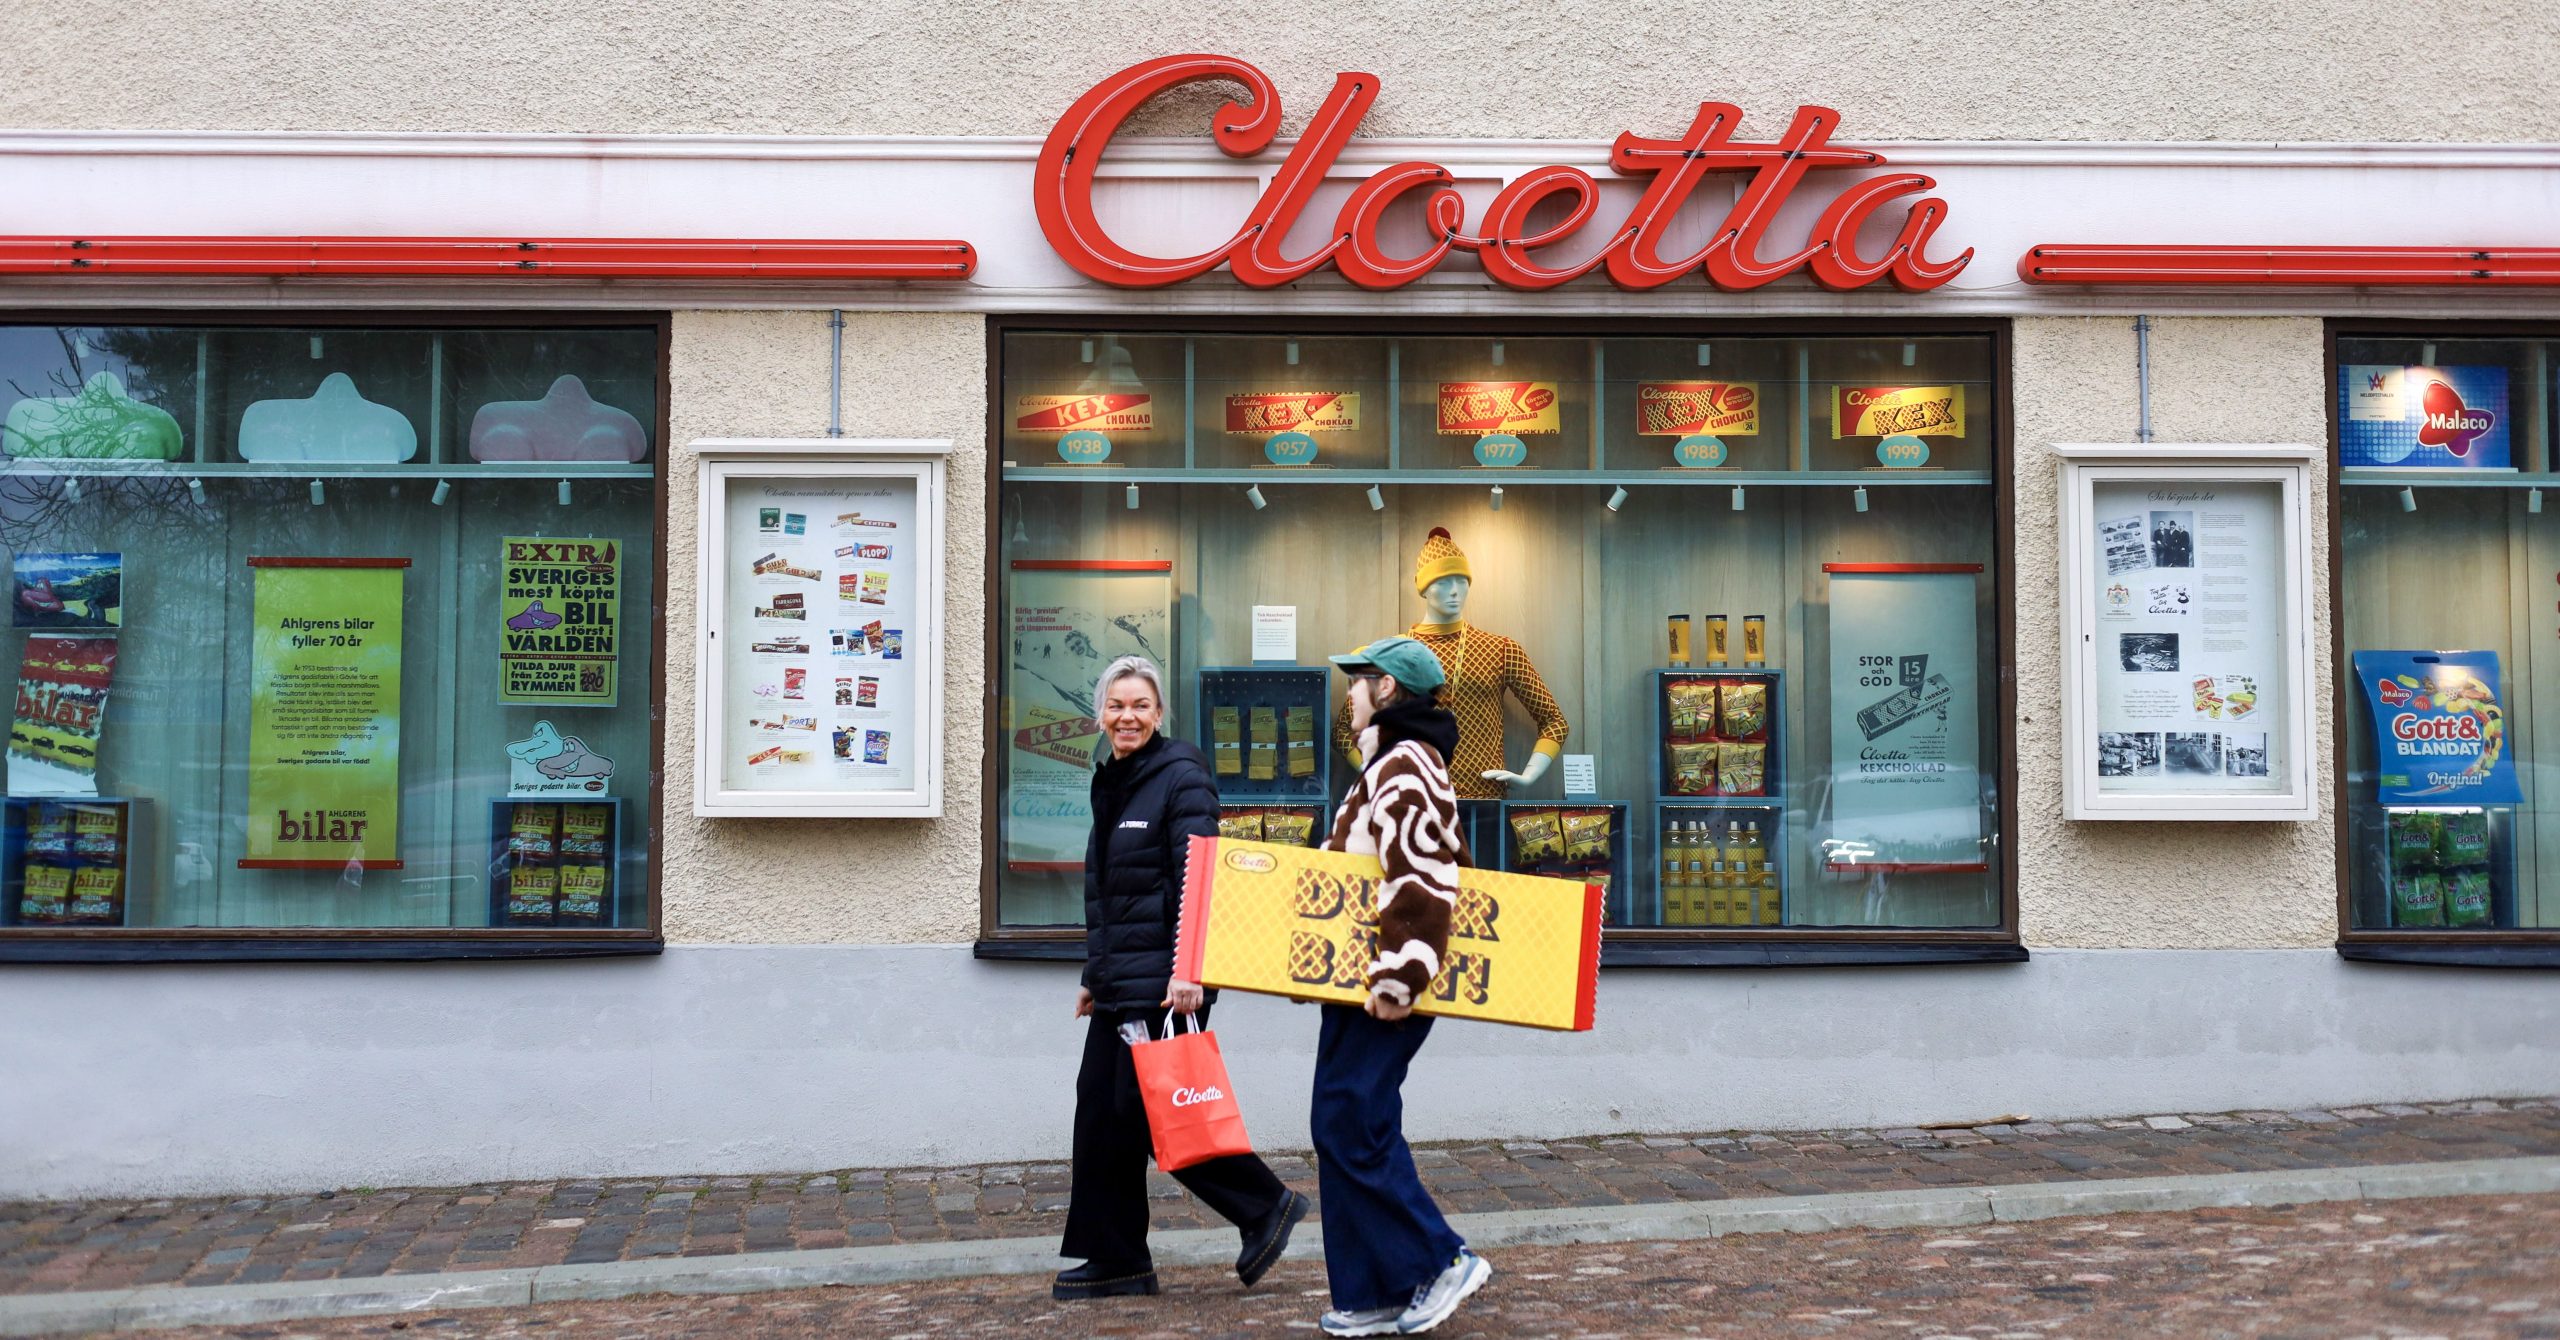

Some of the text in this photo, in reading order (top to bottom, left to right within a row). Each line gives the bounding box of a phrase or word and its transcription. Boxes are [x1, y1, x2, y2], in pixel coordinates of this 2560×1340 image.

[1033, 53, 1975, 293] Cloetta
[1441, 384, 1481, 392] Cloetta
[1641, 386, 1690, 399] Cloetta
[1020, 395, 1058, 406] Cloetta
[1232, 398, 1261, 406] Cloetta
[1847, 391, 1902, 405] Cloetta
[1440, 387, 1525, 426] KEX
[1643, 387, 1724, 433] KEX
[1106, 414, 1150, 424] CHOKLAD
[1507, 412, 1538, 422] CHOKLAD
[1711, 410, 1754, 428] CHOKLAD
[1873, 398, 1955, 435] KEX
[2431, 409, 2488, 430] Malaco
[1067, 440, 1102, 454] 1938
[1275, 441, 1308, 456] 1957
[1483, 444, 1517, 458] 1977
[1683, 445, 1719, 459] 1988
[1887, 445, 1921, 459] 1999
[861, 548, 886, 558] PLOPP
[508, 568, 615, 585] SVERIGES
[864, 575, 887, 585] bilar
[508, 585, 614, 602] mest köpta
[565, 602, 613, 625] BIL
[2149, 605, 2179, 614] Cloetta
[281, 618, 375, 632] Ahlgrens bilar
[564, 626, 613, 635] störst i
[292, 635, 362, 648] fyller 70 år
[507, 631, 612, 652] VÄRLDEN
[511, 662, 576, 671] VILDA DJUR
[1859, 656, 1893, 666] STOR
[1904, 661, 1921, 675] 15
[511, 671, 532, 679] från
[563, 673, 576, 681] på
[1860, 677, 1892, 686] GOD
[511, 681, 576, 691] RYMMEN
[2384, 690, 2410, 698] Malaco
[15, 683, 97, 730] bilar
[1030, 709, 1056, 721] Cloetta
[2393, 713, 2481, 740] Gott&
[1050, 742, 1088, 759] CHOKLAD
[1860, 746, 1910, 760] Cloetta
[2396, 742, 2481, 756] BLANDAT
[1677, 749, 1717, 766] KEX
[1860, 763, 1946, 772] KEXCHOKLAD
[514, 782, 582, 792] Sveriges godaste bilar.
[2427, 772, 2484, 789] Original
[1013, 798, 1088, 817] Cloetta
[277, 809, 368, 842] bilar
[515, 812, 551, 826] bilar
[565, 812, 603, 826] bilar
[1266, 825, 1308, 840] KEX
[1517, 820, 1557, 845] KEX
[1566, 821, 1608, 846] KEX
[2400, 831, 2430, 843] Gott&
[2456, 833, 2484, 844] Gott&
[1231, 854, 1272, 868] Cloetta
[26, 872, 68, 888] bilar
[75, 872, 112, 888] bilar
[513, 874, 552, 888] bilar
[564, 872, 603, 888] bilar
[1295, 867, 1382, 926] DU
[2407, 893, 2436, 905] Gott&
[1287, 927, 1492, 1005] BÄT!
[1172, 1086, 1224, 1107] Cloetta
